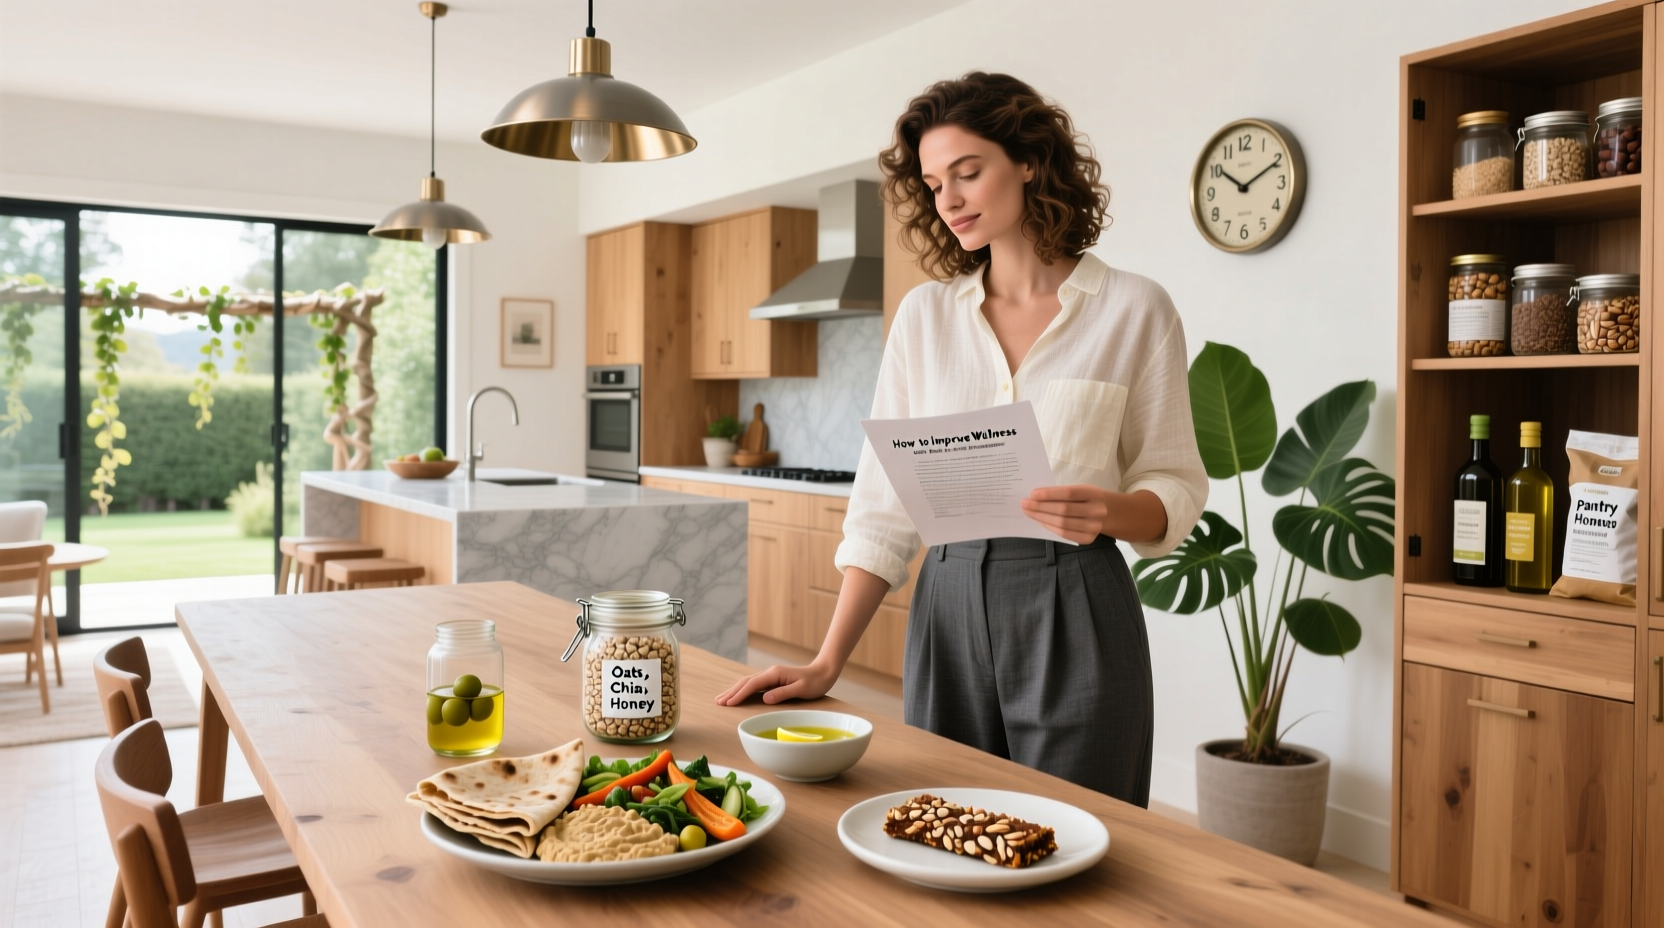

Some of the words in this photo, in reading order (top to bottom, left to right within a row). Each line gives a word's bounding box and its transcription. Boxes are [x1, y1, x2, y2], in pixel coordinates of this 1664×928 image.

[1238, 134, 1252, 152] 12
[1223, 143, 1233, 160] 11
[1274, 153, 1282, 168] 2
[1210, 164, 1223, 179] 10
[1277, 175, 1286, 190] 3
[1207, 186, 1215, 201] 9
[1272, 197, 1281, 212] 4
[1211, 206, 1220, 222] 8
[1224, 220, 1232, 237] 7
[1240, 224, 1249, 240] 6
[1259, 217, 1267, 232] 5
[892, 438, 915, 449] How
[918, 438, 929, 446] to
[1576, 499, 1618, 518] Pantry
[611, 665, 650, 681] Oats,
[610, 681, 649, 695] Chia,
[610, 697, 655, 713] Honey
